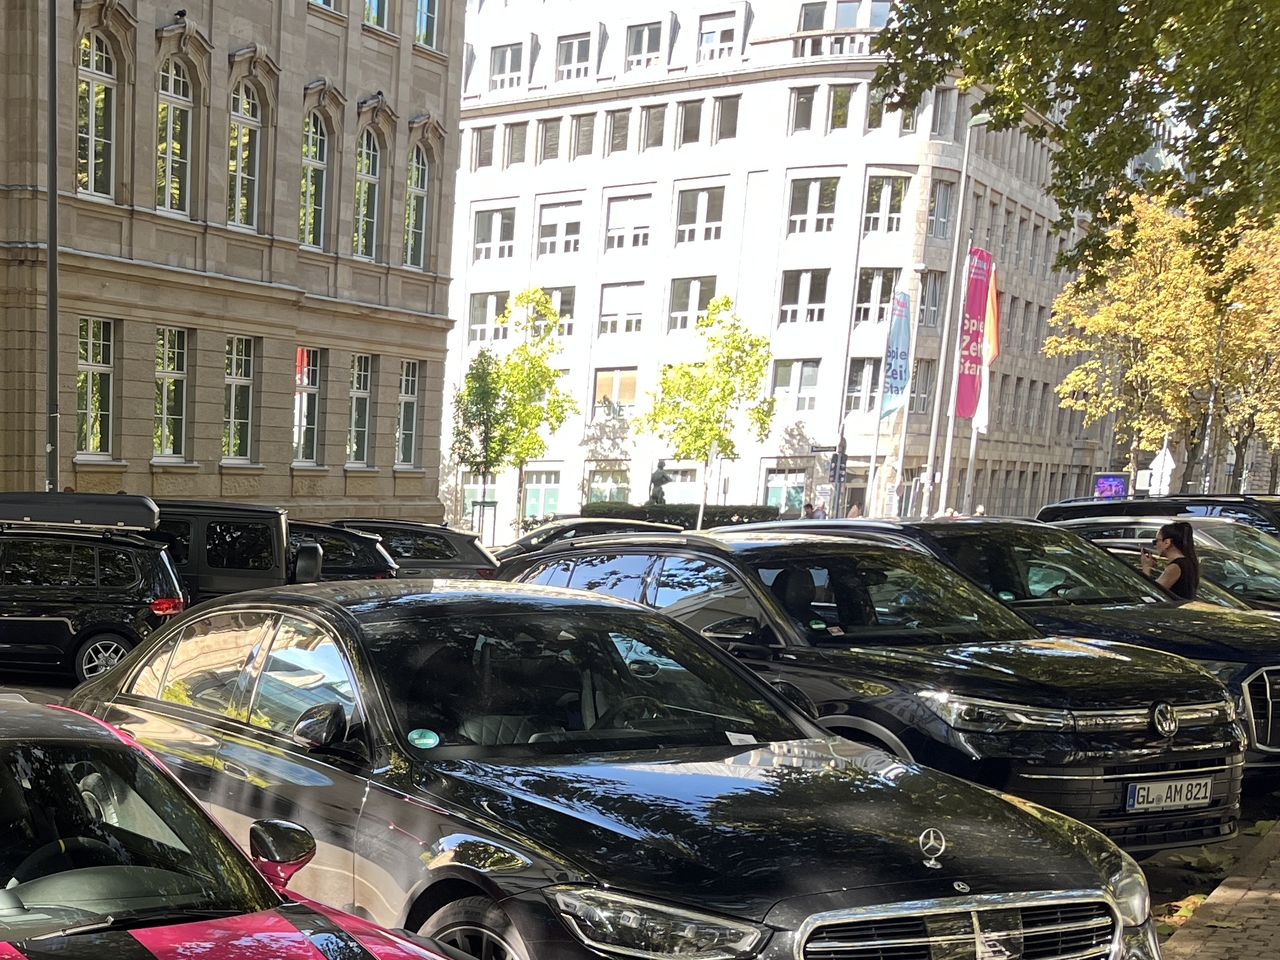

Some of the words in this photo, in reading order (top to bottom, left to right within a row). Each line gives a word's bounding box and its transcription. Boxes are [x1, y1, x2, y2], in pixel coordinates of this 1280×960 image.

[961, 335, 983, 357] Zei
[1136, 786, 1155, 805] GL
[1164, 784, 1183, 803] AM
[1185, 781, 1209, 801] 821
